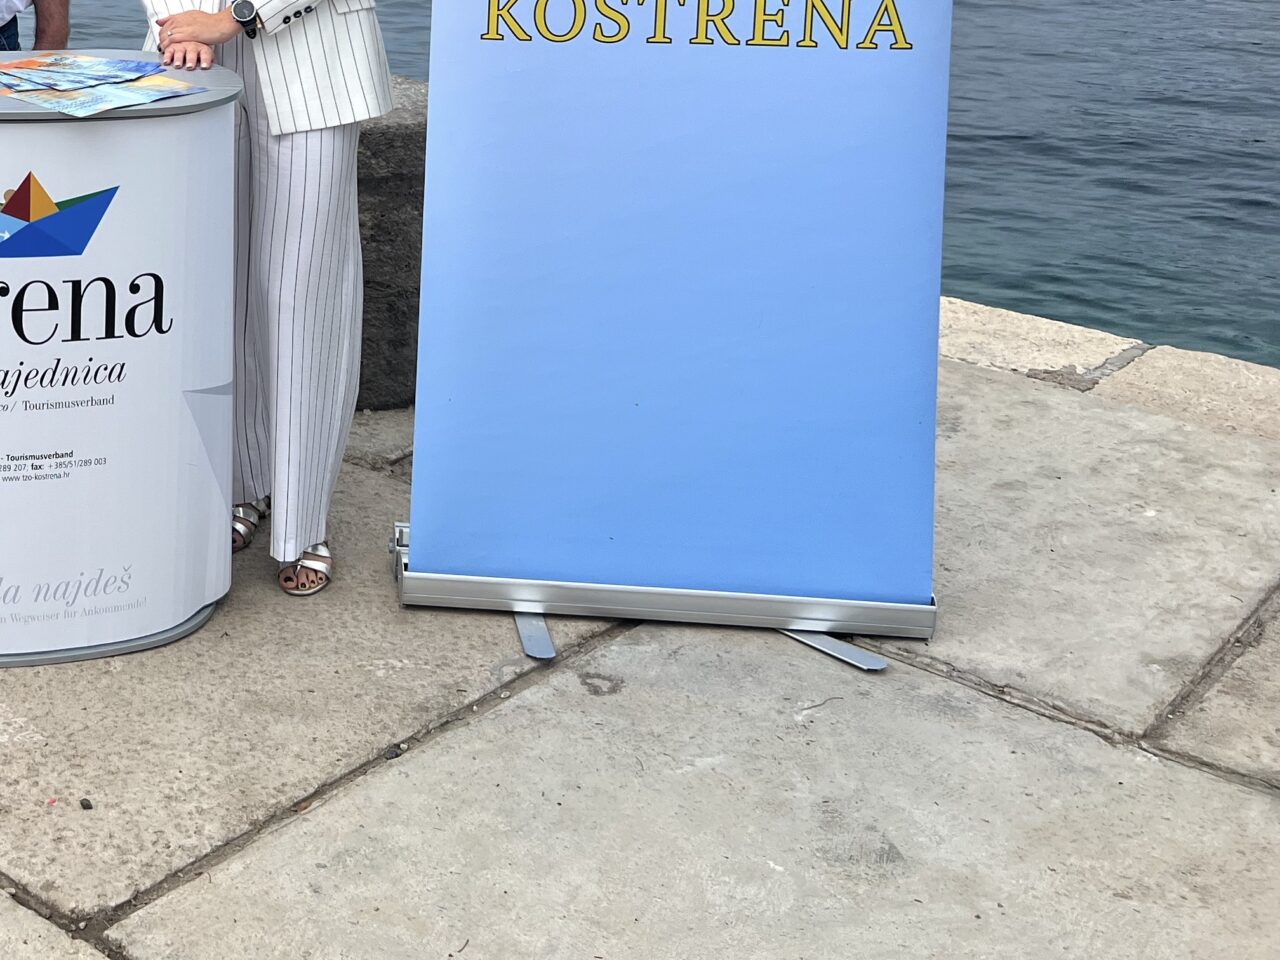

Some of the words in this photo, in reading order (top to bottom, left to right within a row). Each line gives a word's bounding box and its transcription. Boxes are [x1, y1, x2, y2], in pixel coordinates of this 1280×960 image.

[22, 394, 115, 411] Tourismusverband
[5, 450, 74, 462] Tourismusverband
[31, 462, 45, 471] fax:
[93, 457, 107, 466] 003
[33, 564, 133, 608] najdeš
[10, 612, 59, 625] Wegweiser
